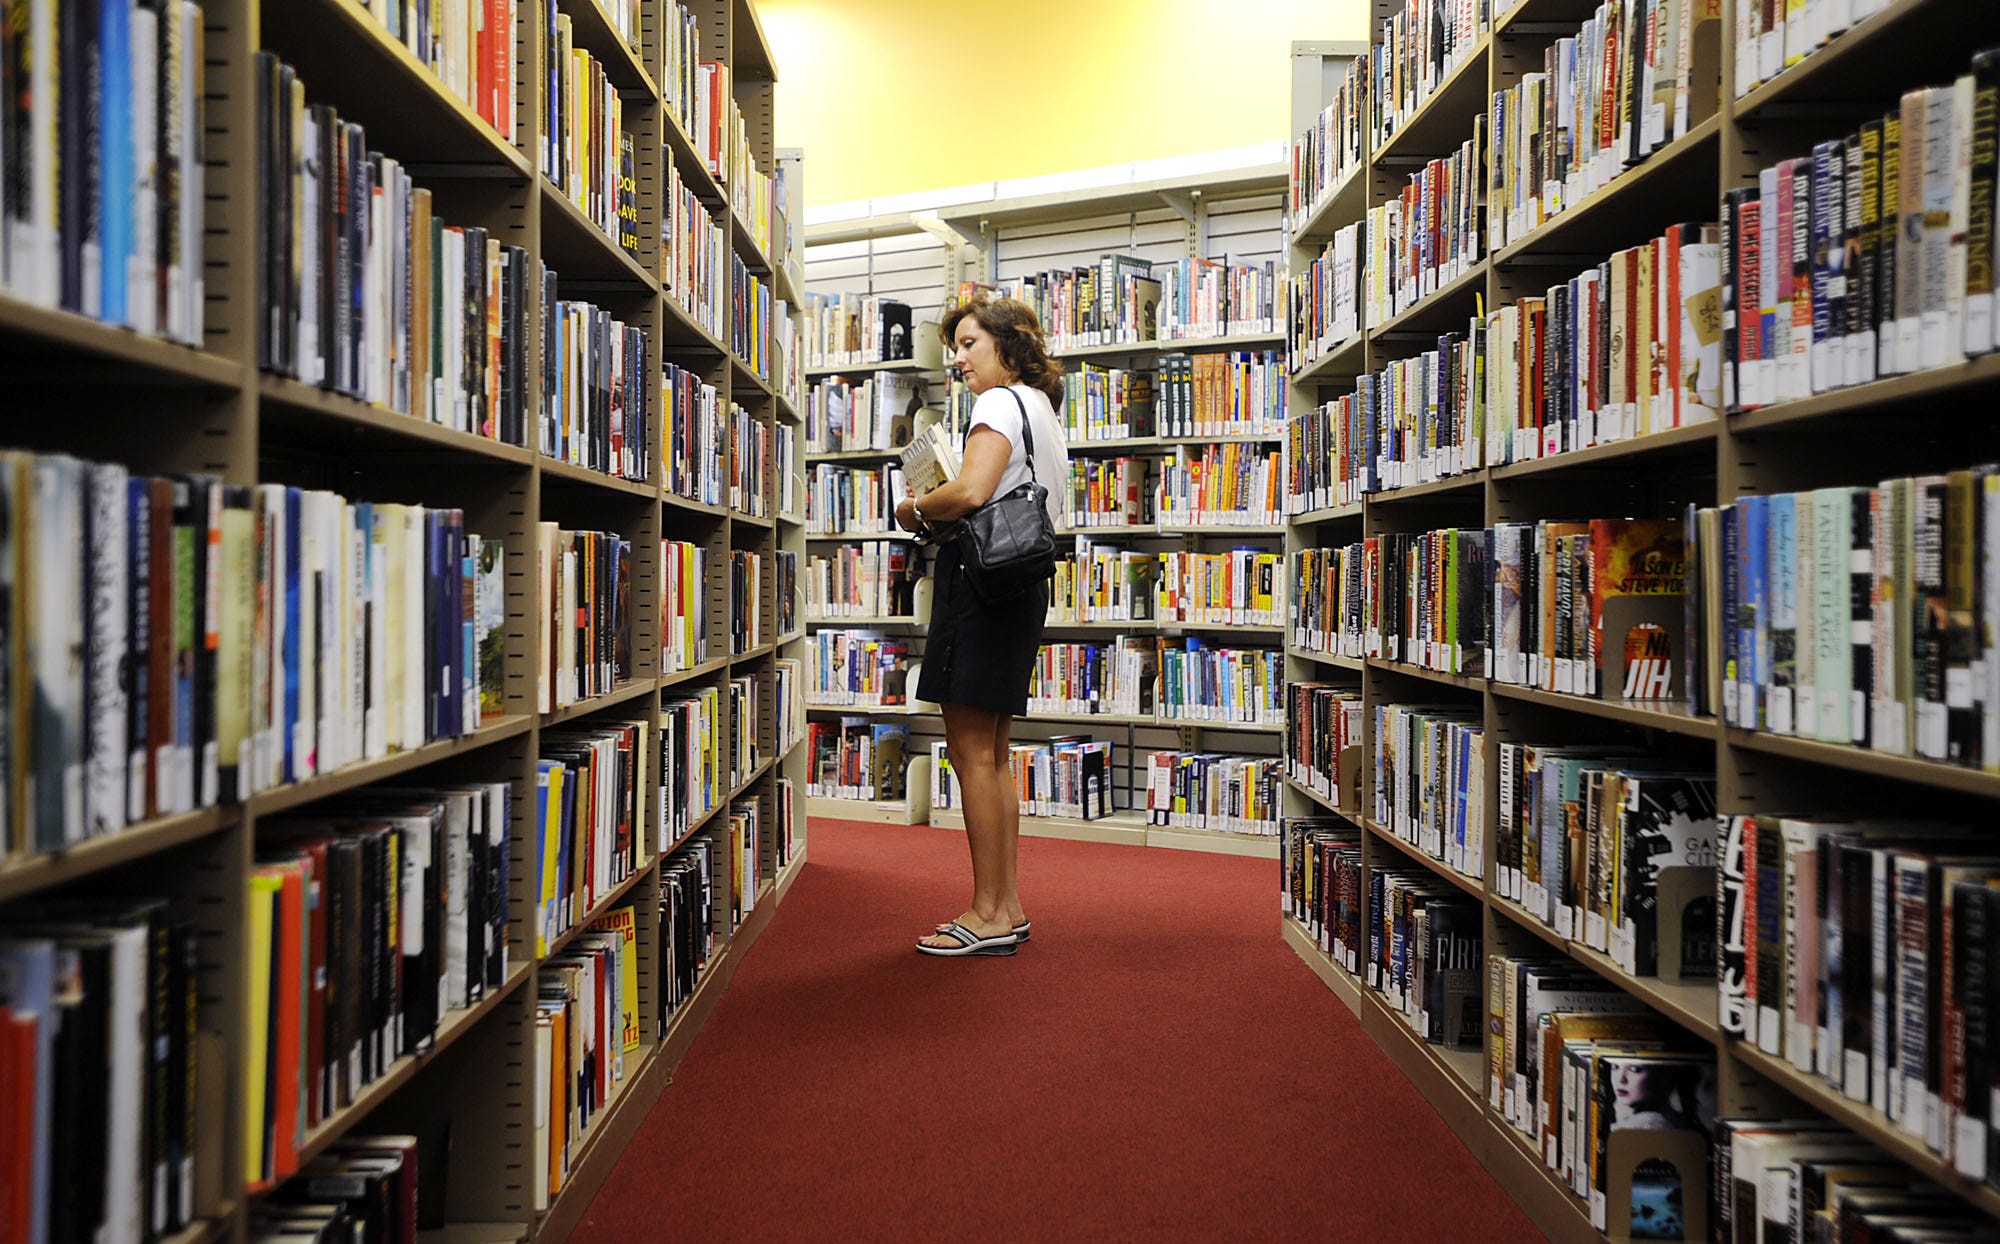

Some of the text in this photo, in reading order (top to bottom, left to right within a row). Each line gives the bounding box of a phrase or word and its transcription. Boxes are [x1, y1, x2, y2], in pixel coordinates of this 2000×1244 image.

[1605, 37, 1615, 79] Queen
[1603, 94, 1613, 137] Swords
[1828, 156, 1843, 237] JOY FIELDING
[1846, 146, 1862, 229] JOY FIELDING
[1861, 130, 1879, 224] JOY FIELDING
[1883, 120, 1900, 217] JOY FIELDING
[1908, 139, 1922, 204] FIELDING
[1967, 88, 1996, 287] KILLER INSTINCT
[621, 232, 639, 251] LIFE
[1793, 175, 1808, 263] JOY FIELDING
[1102, 258, 1112, 312] RAMBLERS
[1742, 207, 1760, 311] TELL ME NO SECRETS
[1848, 278, 1859, 331] PUPP
[1350, 546, 1361, 614] PATRICIA CORNWELL
[1562, 549, 1571, 574] CRY
[1618, 577, 1657, 593] STEVE
[1819, 504, 1831, 658] FANNIE FLAGG
[1562, 578, 1571, 618] HAVOC
[1927, 498, 1941, 698] JOY FIELDING PUPP
[1622, 659, 1673, 698] JIHA
[1759, 869, 1780, 945] FOLLETT
[1392, 933, 1404, 985] PLUM ISLAN
[1966, 948, 1986, 1047] FOLLETT
[1491, 1038, 1500, 1075] Middle
